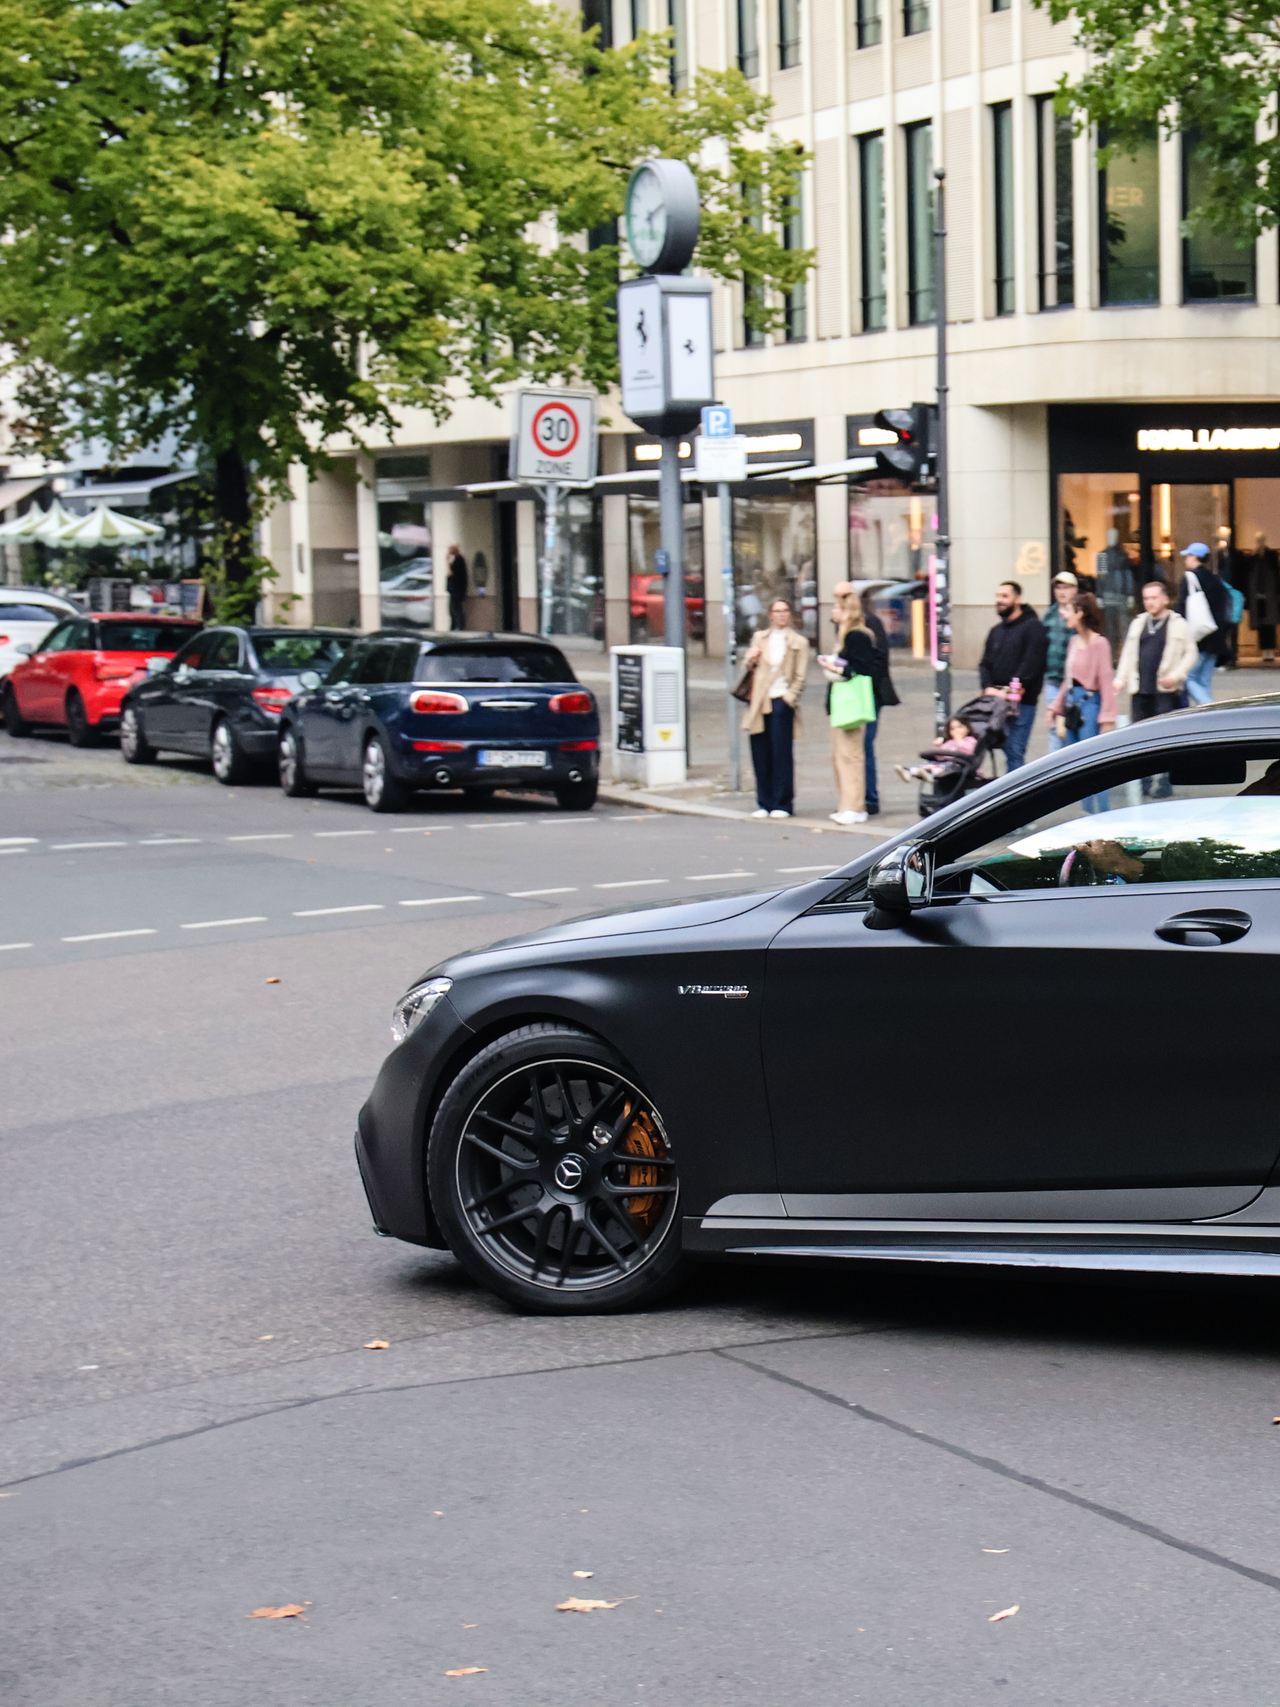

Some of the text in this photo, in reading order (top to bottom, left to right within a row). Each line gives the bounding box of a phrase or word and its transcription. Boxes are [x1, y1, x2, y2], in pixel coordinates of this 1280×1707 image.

[542, 416, 569, 442] 30
[708, 411, 727, 434] P
[535, 460, 573, 476] ZONE
[678, 985, 701, 994] V8
